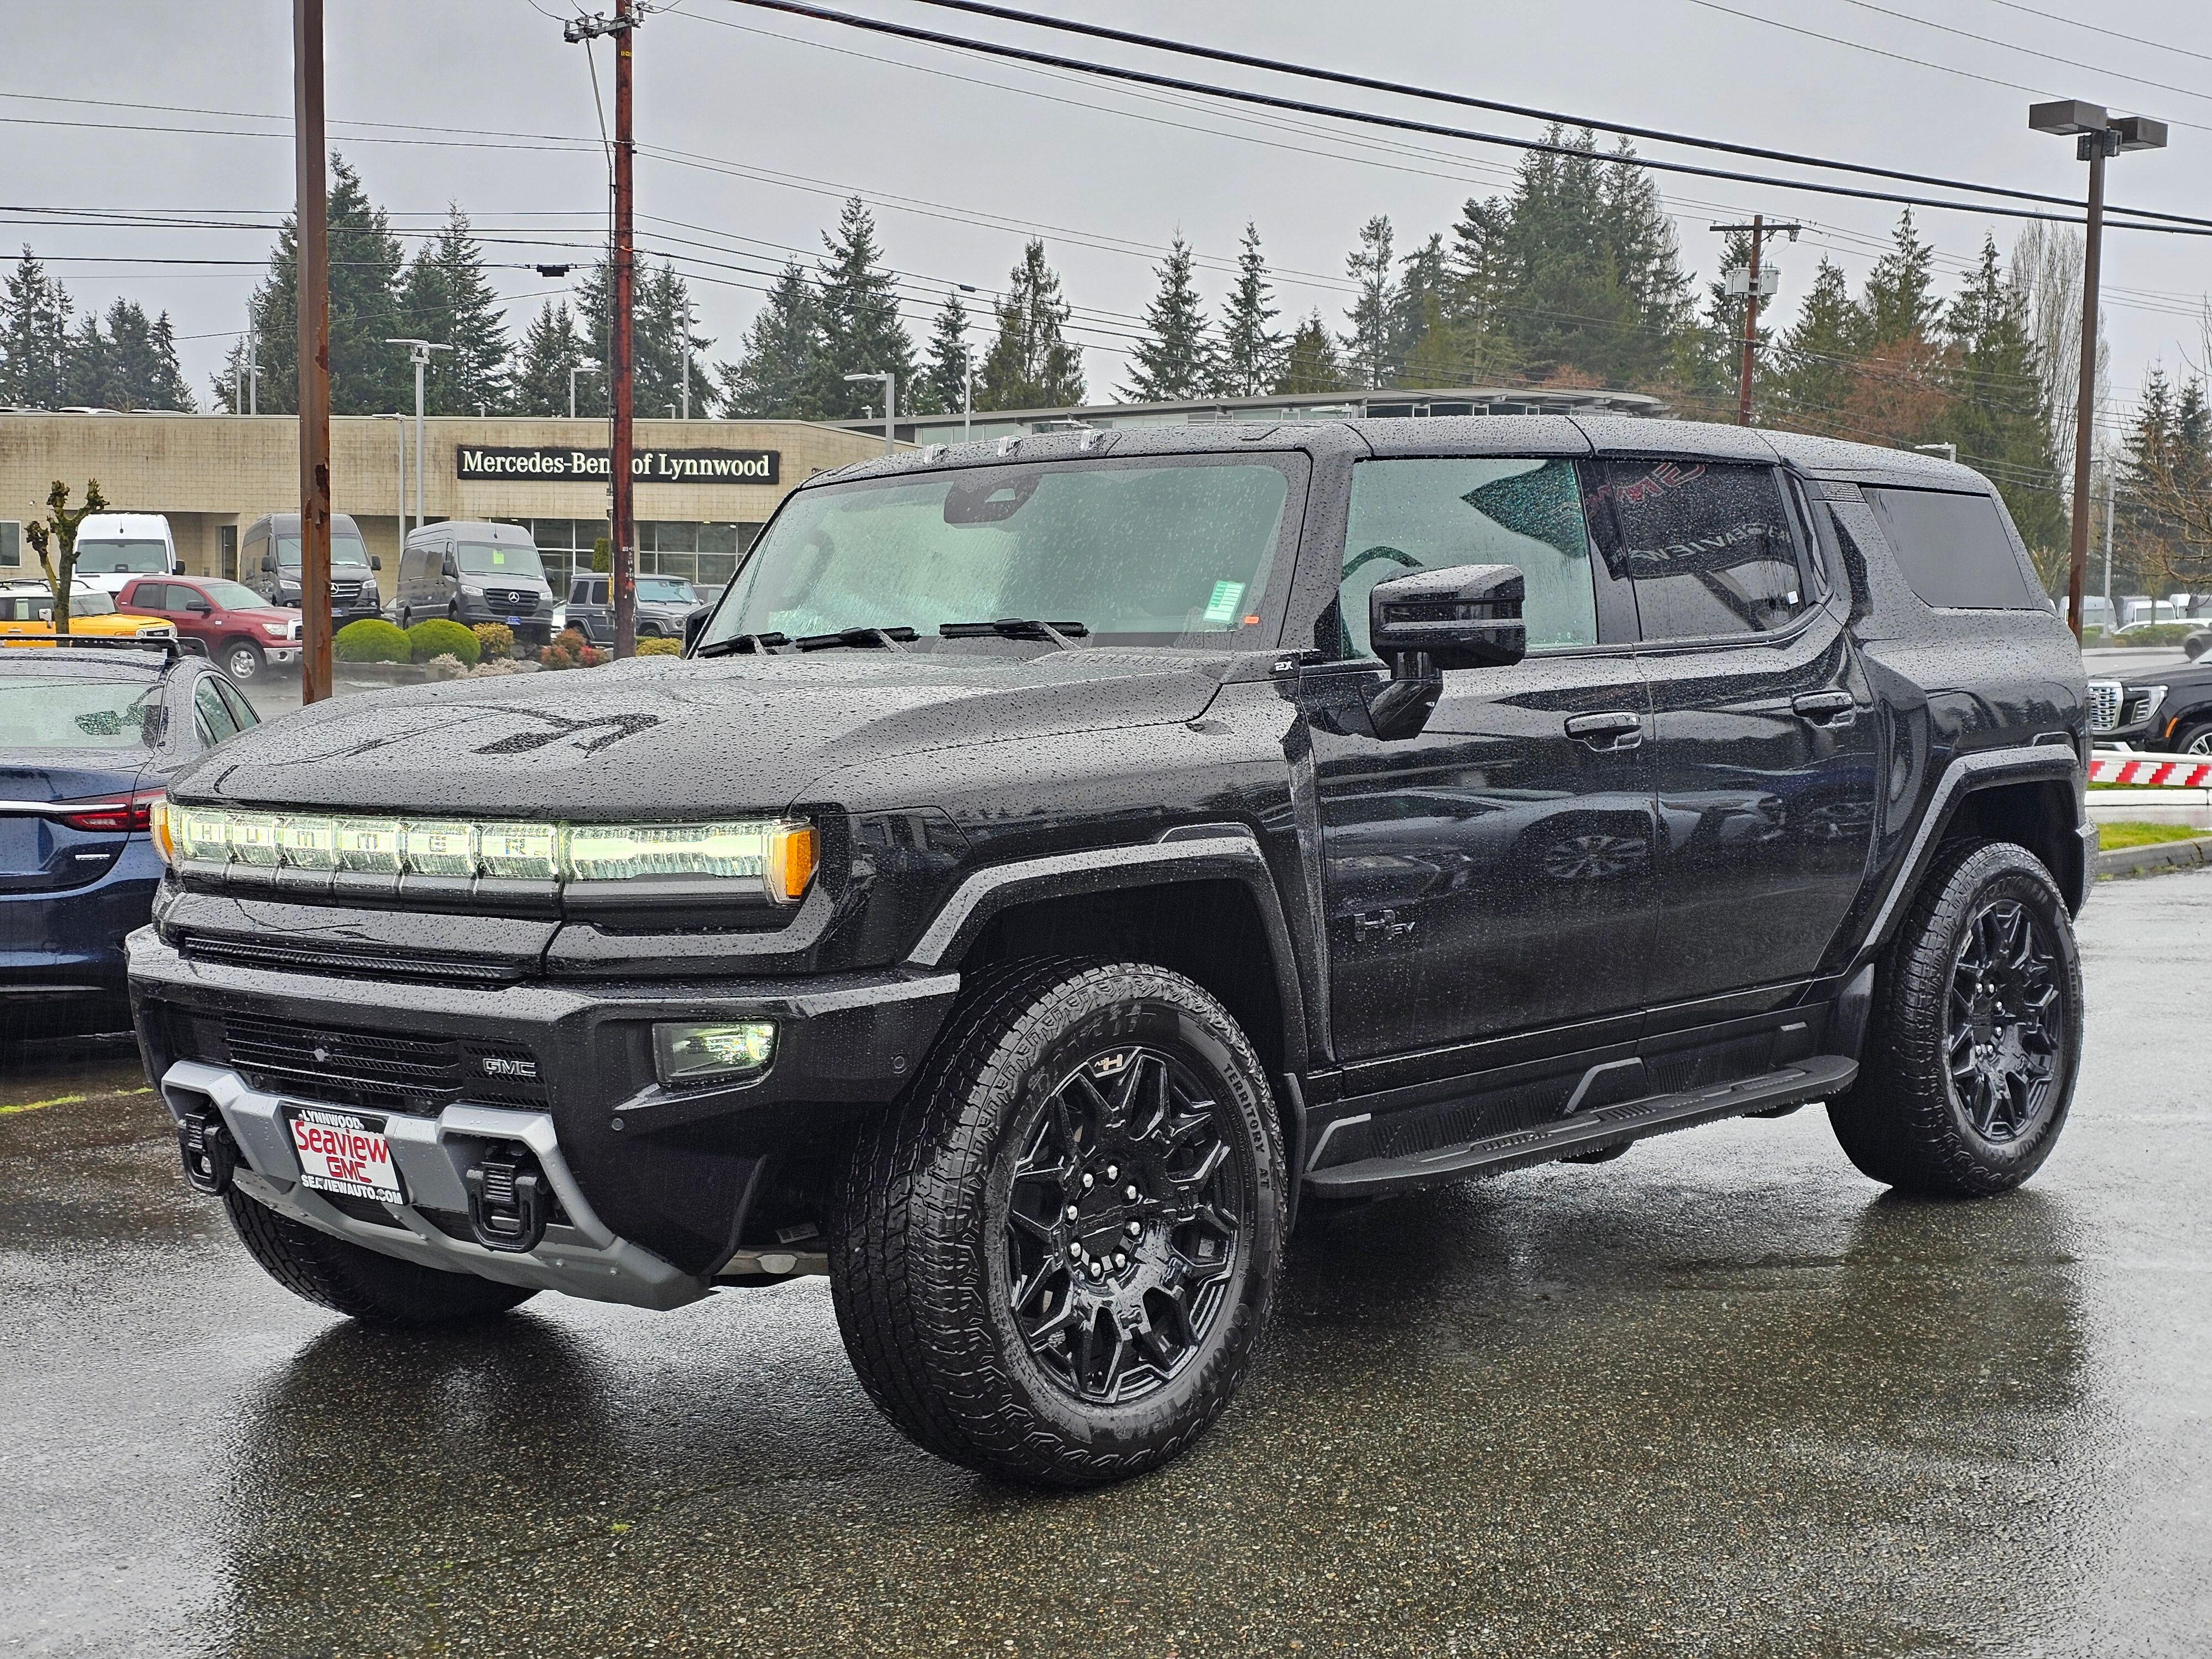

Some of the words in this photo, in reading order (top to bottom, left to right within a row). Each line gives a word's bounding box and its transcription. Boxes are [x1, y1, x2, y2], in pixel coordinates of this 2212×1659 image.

[463, 451, 613, 474] Mercedes-Ben
[632, 453, 653, 475] of
[659, 453, 770, 480] Lynnwood
[1275, 661, 1293, 671] 2X
[202, 825, 526, 856] HUMMER
[483, 1058, 536, 1077] GMC
[301, 1110, 361, 1129] LYNNWOOD
[1223, 1063, 1265, 1153] TERRITORY
[1259, 1167, 1270, 1189] AT
[295, 1121, 388, 1164] Seaview
[326, 1156, 372, 1183] GMC
[301, 1175, 404, 1205] SEAVIEWAUTO.COM
